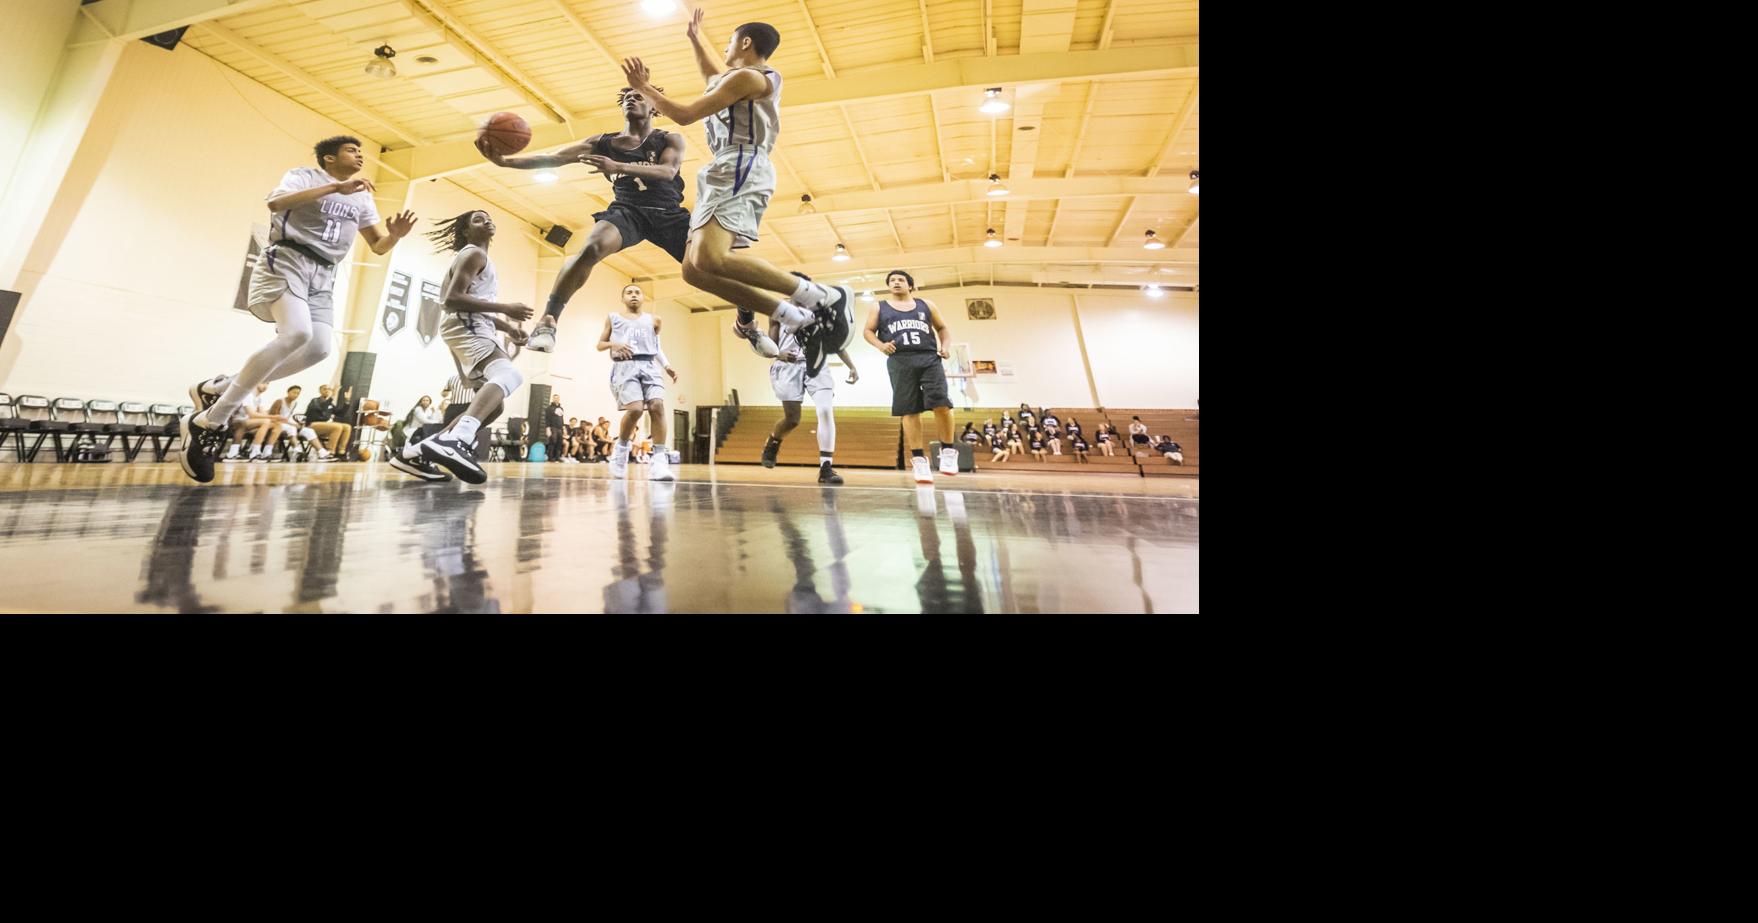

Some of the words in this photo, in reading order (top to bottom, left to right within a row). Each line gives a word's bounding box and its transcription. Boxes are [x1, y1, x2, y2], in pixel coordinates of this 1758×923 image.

[634, 177, 647, 191] 1
[321, 200, 358, 219] LIONS
[322, 219, 341, 243] 11
[902, 331, 921, 345] 15
